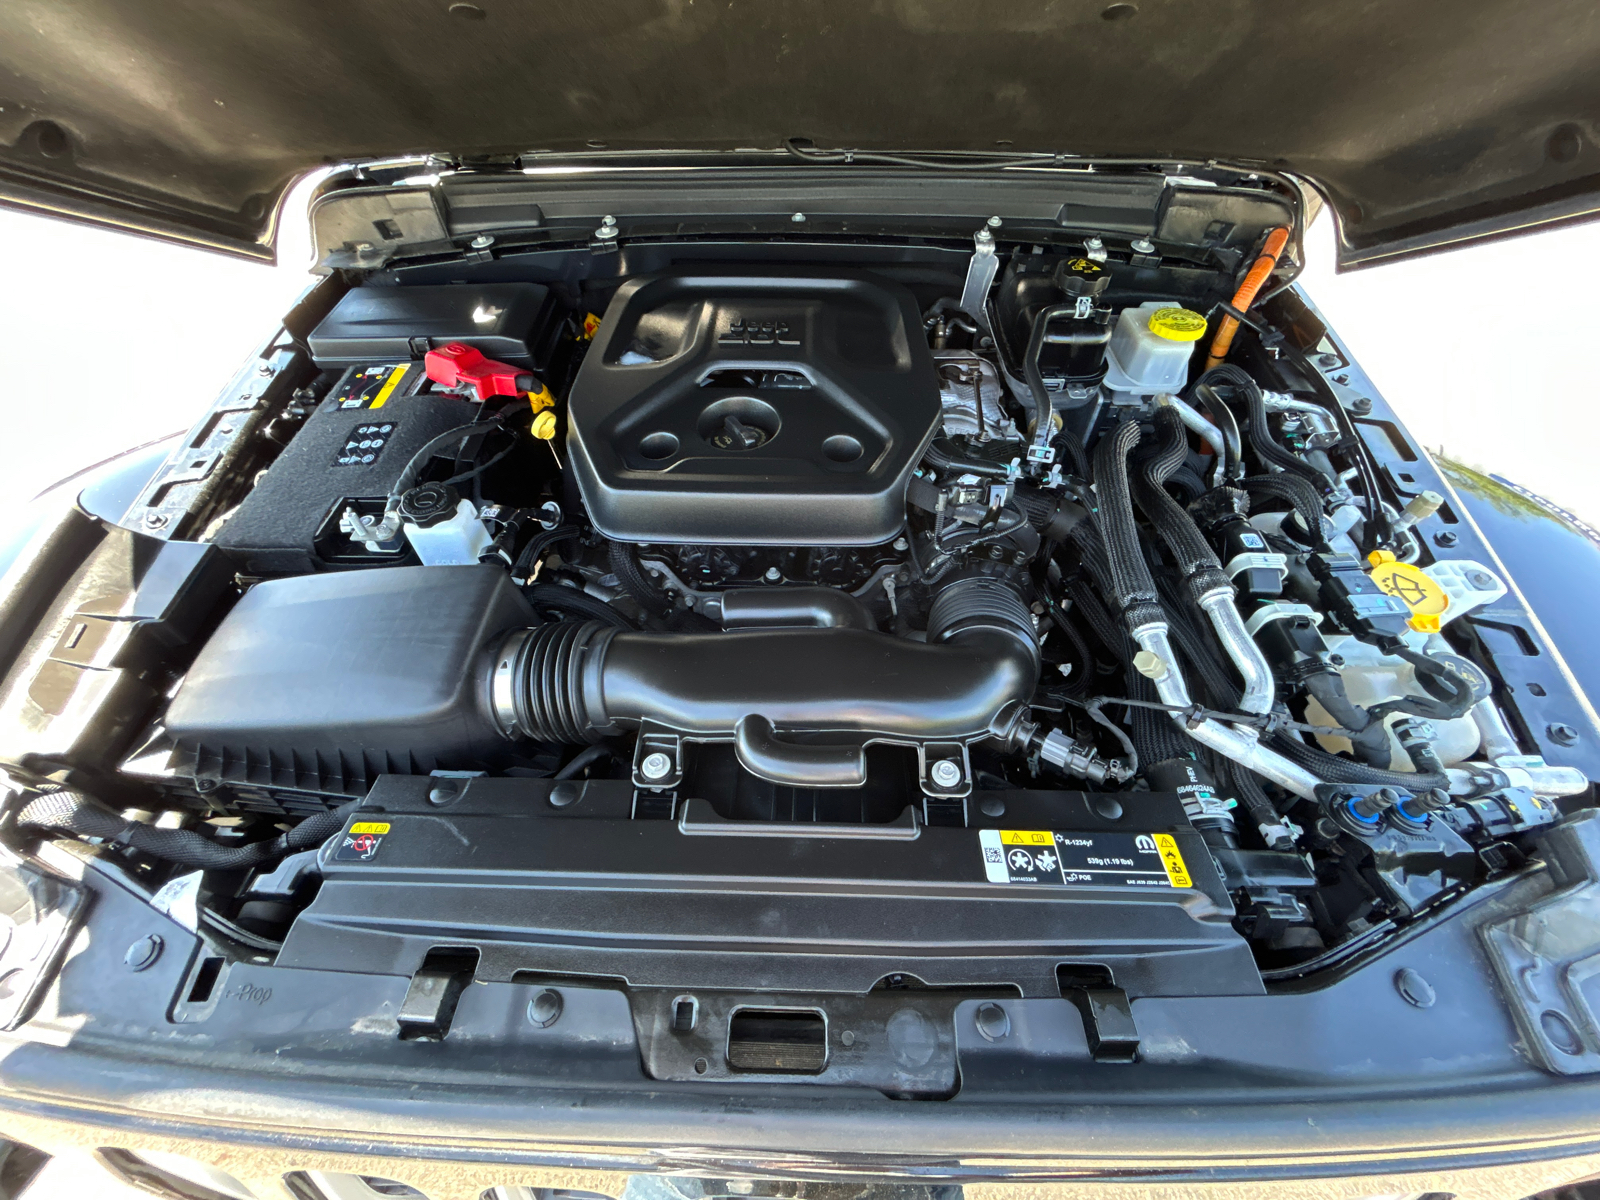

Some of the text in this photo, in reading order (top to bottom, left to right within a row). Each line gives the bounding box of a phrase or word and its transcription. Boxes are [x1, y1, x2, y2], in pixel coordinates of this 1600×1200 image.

[730, 318, 790, 334] Jeep
[1185, 766, 1199, 783] PHEV
[238, 982, 273, 1006] Prop
